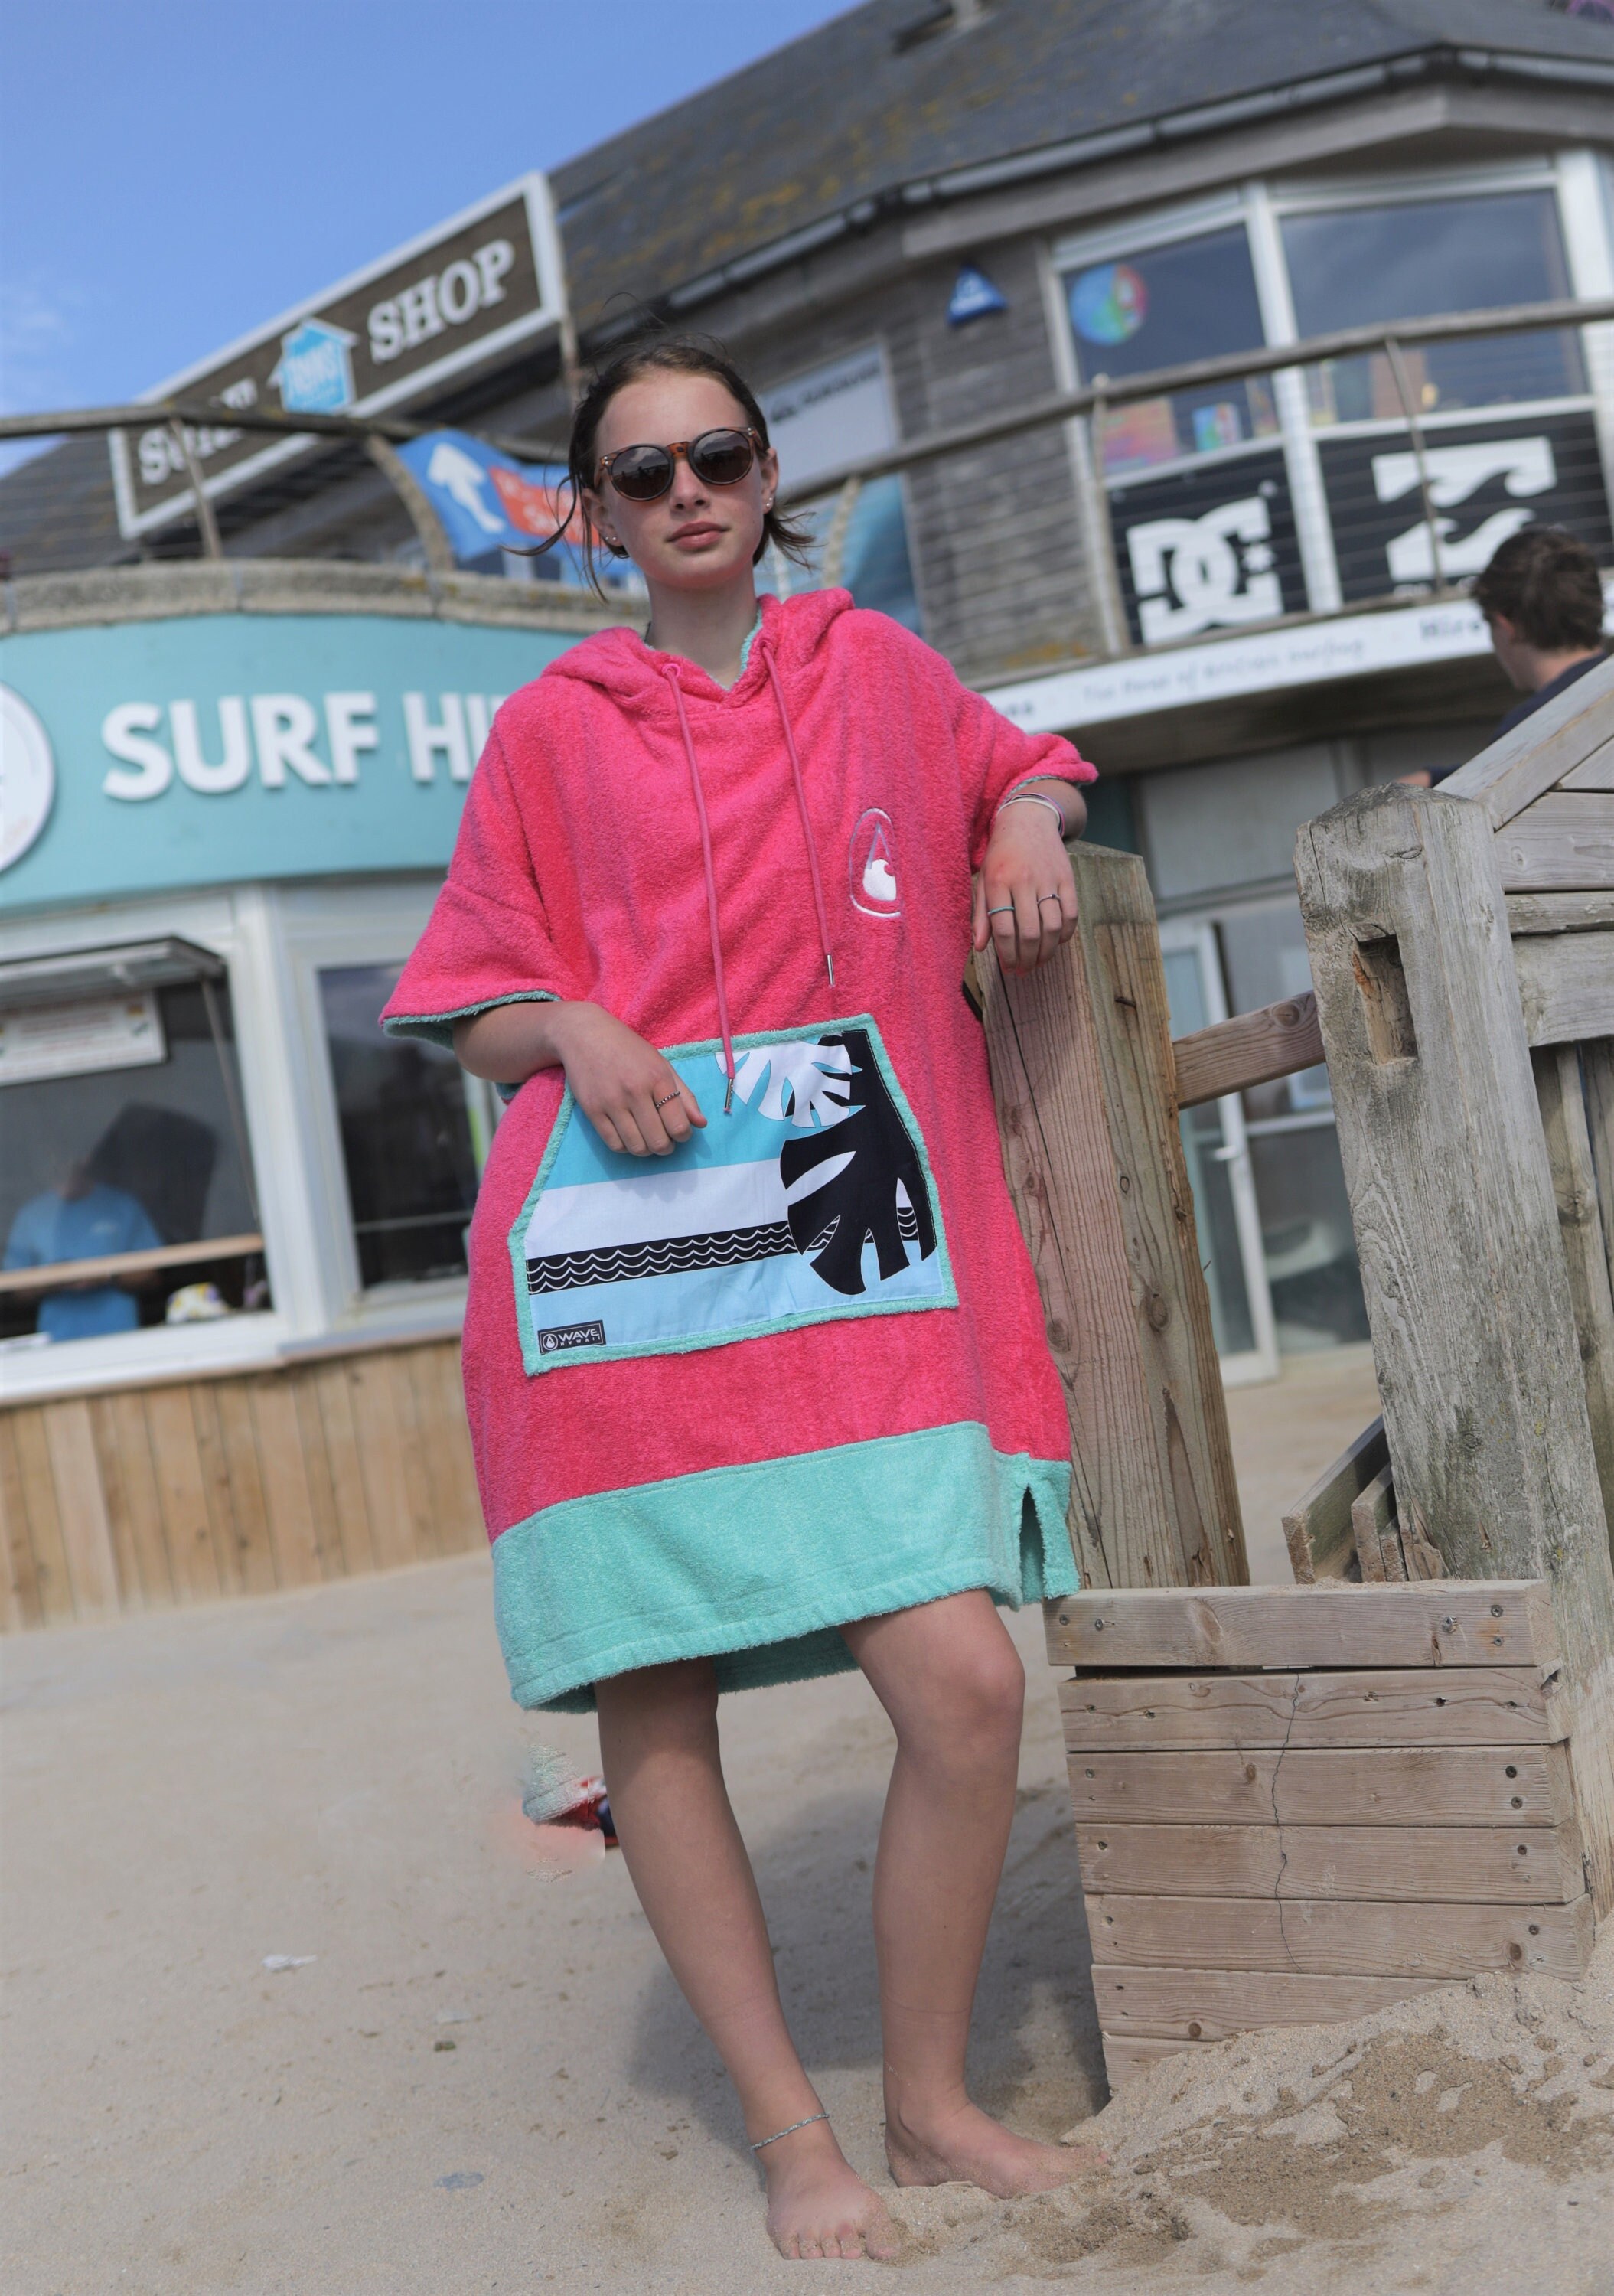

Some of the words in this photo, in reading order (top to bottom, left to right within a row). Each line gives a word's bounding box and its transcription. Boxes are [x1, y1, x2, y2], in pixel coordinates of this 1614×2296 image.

[367, 239, 516, 366] SHOP
[101, 691, 379, 801] SURF
[403, 691, 508, 781] HI
[558, 1329, 600, 1342] WAVE
